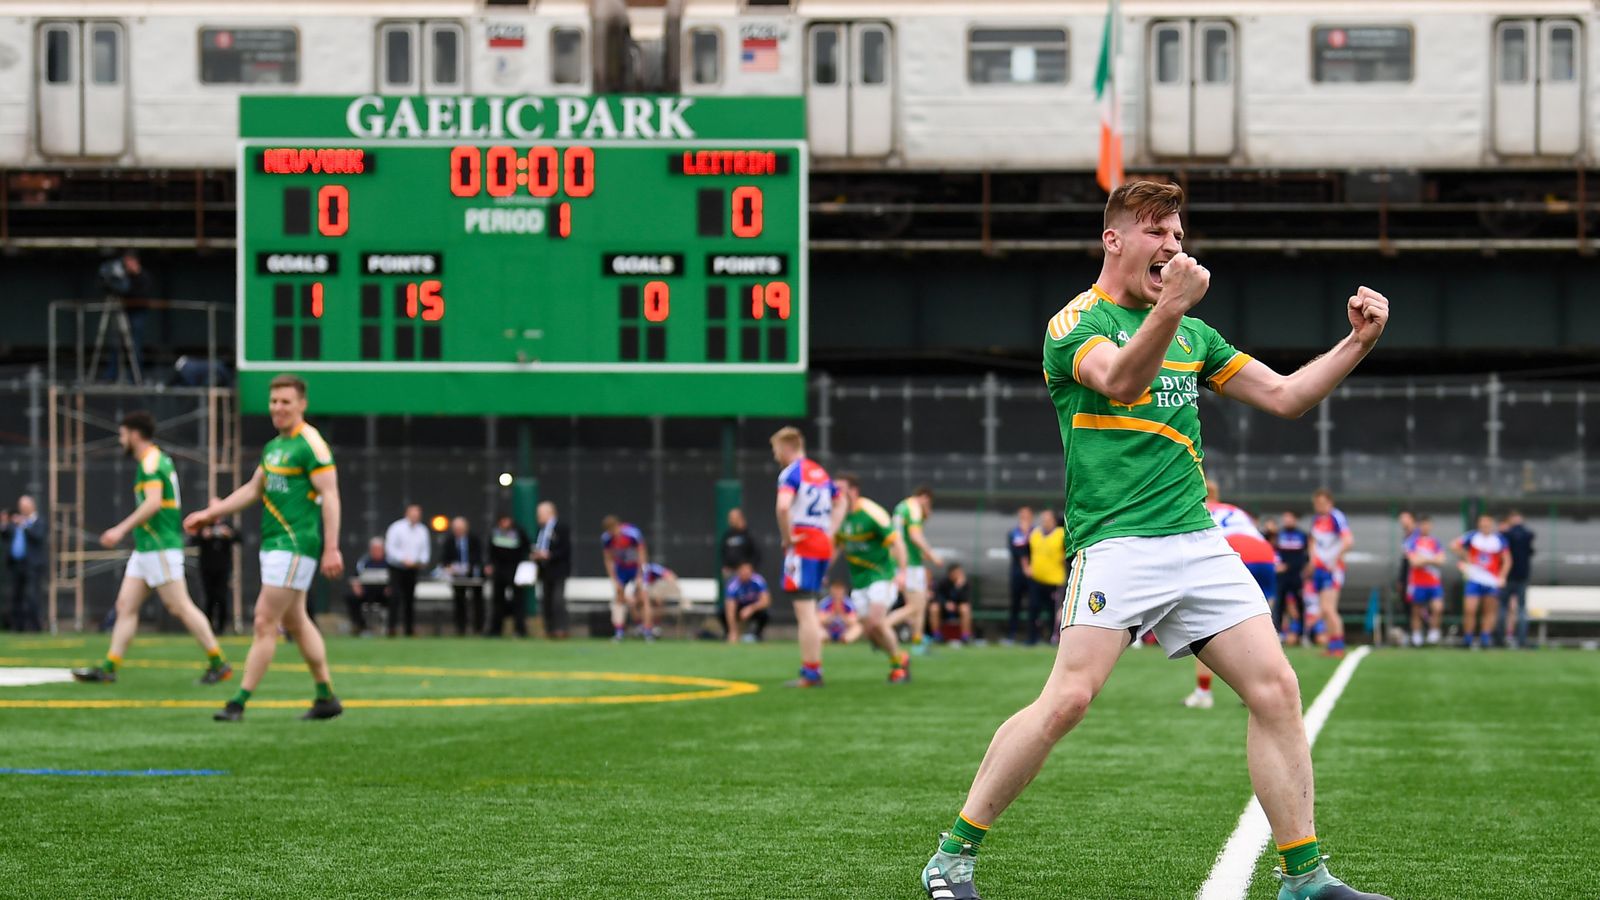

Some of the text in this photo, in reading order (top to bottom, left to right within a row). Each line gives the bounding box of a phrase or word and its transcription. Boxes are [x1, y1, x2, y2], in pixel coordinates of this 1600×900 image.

[346, 96, 695, 139] GAELIC PARK
[450, 145, 595, 198] 00:00
[318, 185, 349, 237] 0
[464, 208, 545, 234] PERIOD
[559, 202, 571, 238] 1
[731, 186, 763, 238] 0
[266, 254, 330, 273] GOALS
[367, 254, 436, 273] POINTS
[612, 255, 675, 274] GOALS
[713, 255, 782, 274] POINTS
[312, 281, 323, 319] 1
[406, 280, 445, 321] 15
[643, 281, 670, 322] 0
[752, 281, 791, 320] 19
